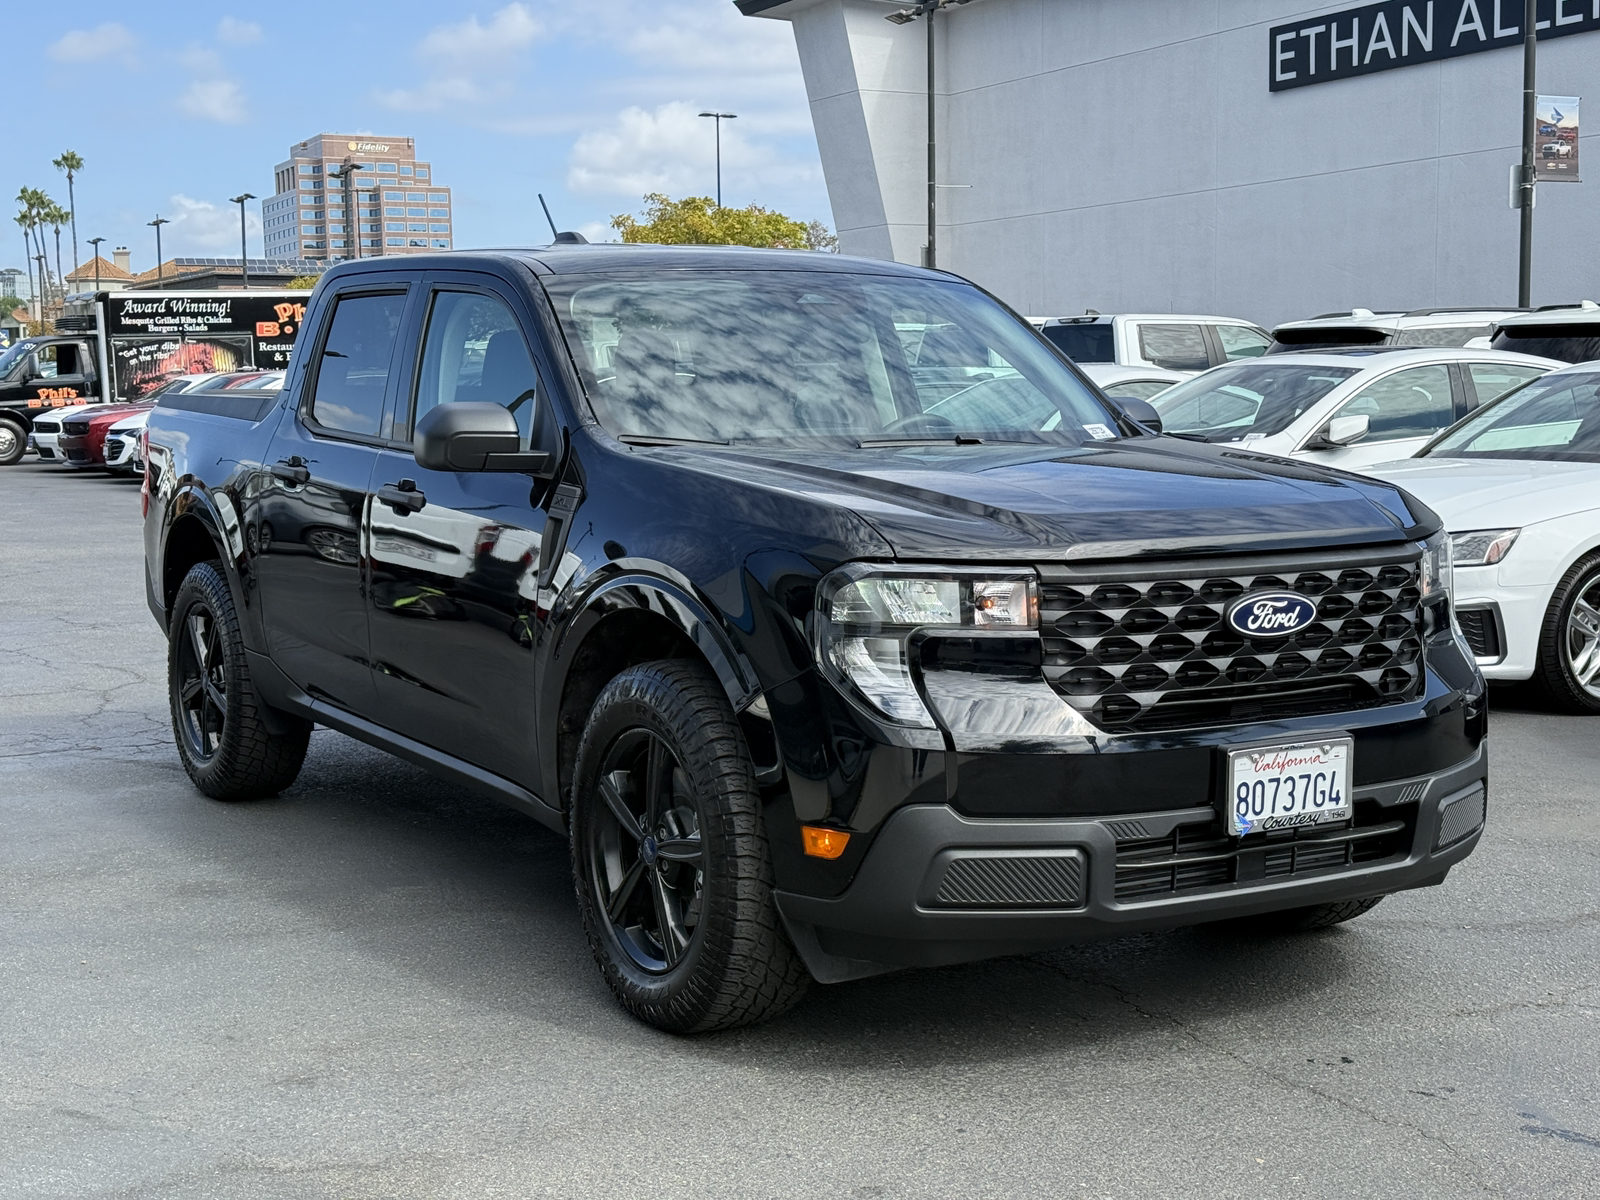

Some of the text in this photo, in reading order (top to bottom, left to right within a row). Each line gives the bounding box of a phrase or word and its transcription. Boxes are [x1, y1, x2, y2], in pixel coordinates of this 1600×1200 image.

[1275, 0, 1600, 82] ETHAN ALE
[357, 143, 390, 153] Fidelity
[120, 298, 231, 316] Award Winning!
[121, 317, 154, 326] Mesquite
[180, 316, 197, 324] Ribs
[197, 316, 204, 324] &
[204, 315, 232, 323] Chicken
[148, 324, 208, 333] Burgers Salads
[139, 344, 159, 354] your
[161, 341, 180, 350] dibs
[139, 353, 152, 362] the
[274, 352, 284, 361] &
[37, 387, 79, 400] Phil's
[1247, 600, 1301, 630] Ford
[1254, 751, 1328, 775] California
[1236, 770, 1341, 817] 80737G4
[1262, 812, 1321, 831] Courtesy
